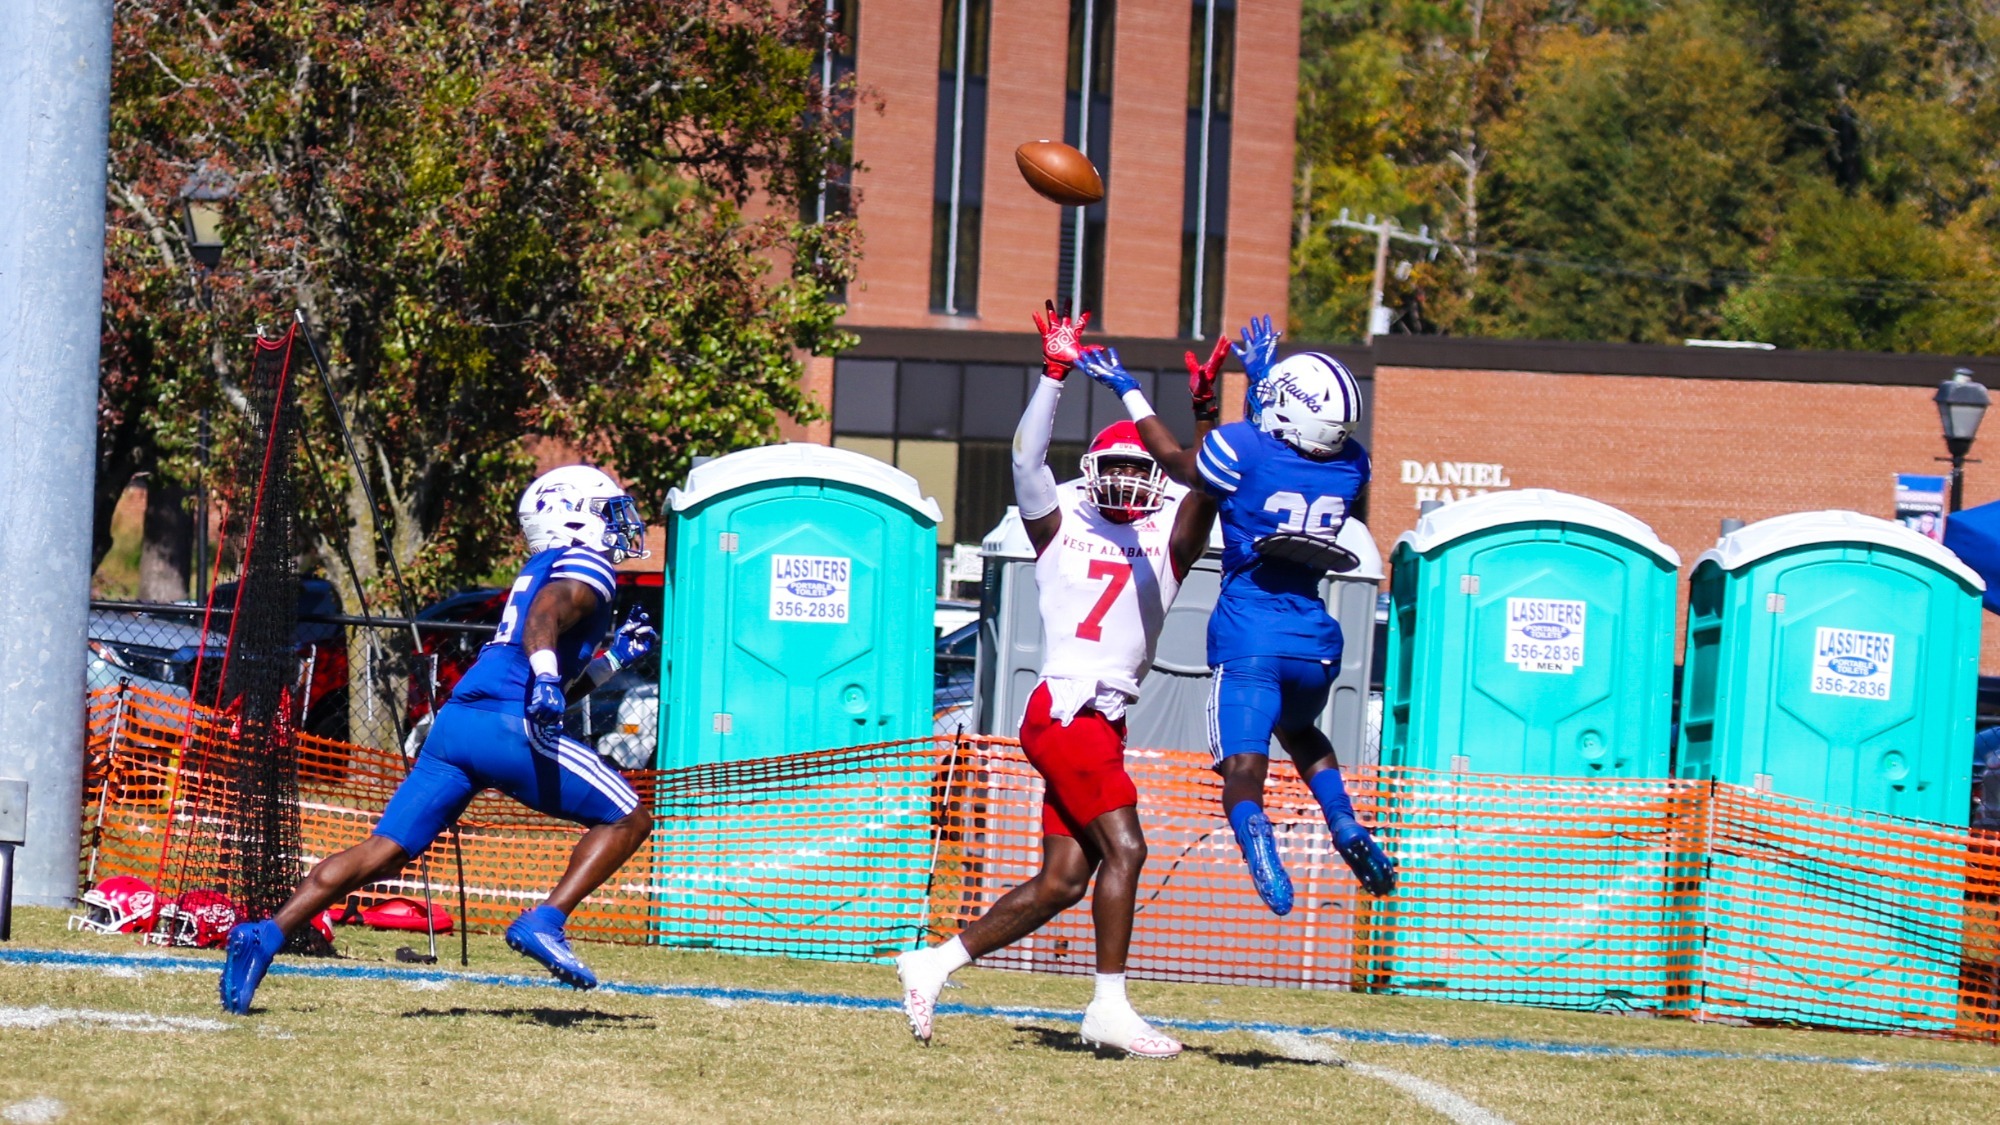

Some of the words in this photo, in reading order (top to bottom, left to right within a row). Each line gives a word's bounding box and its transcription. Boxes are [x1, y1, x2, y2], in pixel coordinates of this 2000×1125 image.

[1273, 372, 1322, 414] Hawks
[1400, 459, 1511, 487] DANIEL
[1414, 485, 1489, 510] HA
[1063, 534, 1095, 553] WEST
[1100, 546, 1161, 558] ALABAMA
[776, 558, 847, 582] LASSITERS
[790, 582, 833, 591] PORTABLE
[796, 589, 828, 597] TOILETS
[775, 601, 845, 618] 356-2836
[1075, 559, 1133, 642] 7
[1512, 601, 1582, 625] LASSITERS
[1525, 625, 1568, 634] PORTABLE
[1531, 631, 1562, 639] TOILETS
[1511, 643, 1580, 661] 356-2836
[1819, 630, 1890, 663] LASSITERS
[1537, 662, 1563, 671] MEN
[1831, 659, 1875, 669] PORTABLE
[1837, 666, 1869, 676] TOILETS
[1815, 676, 1886, 696] 356-2836
